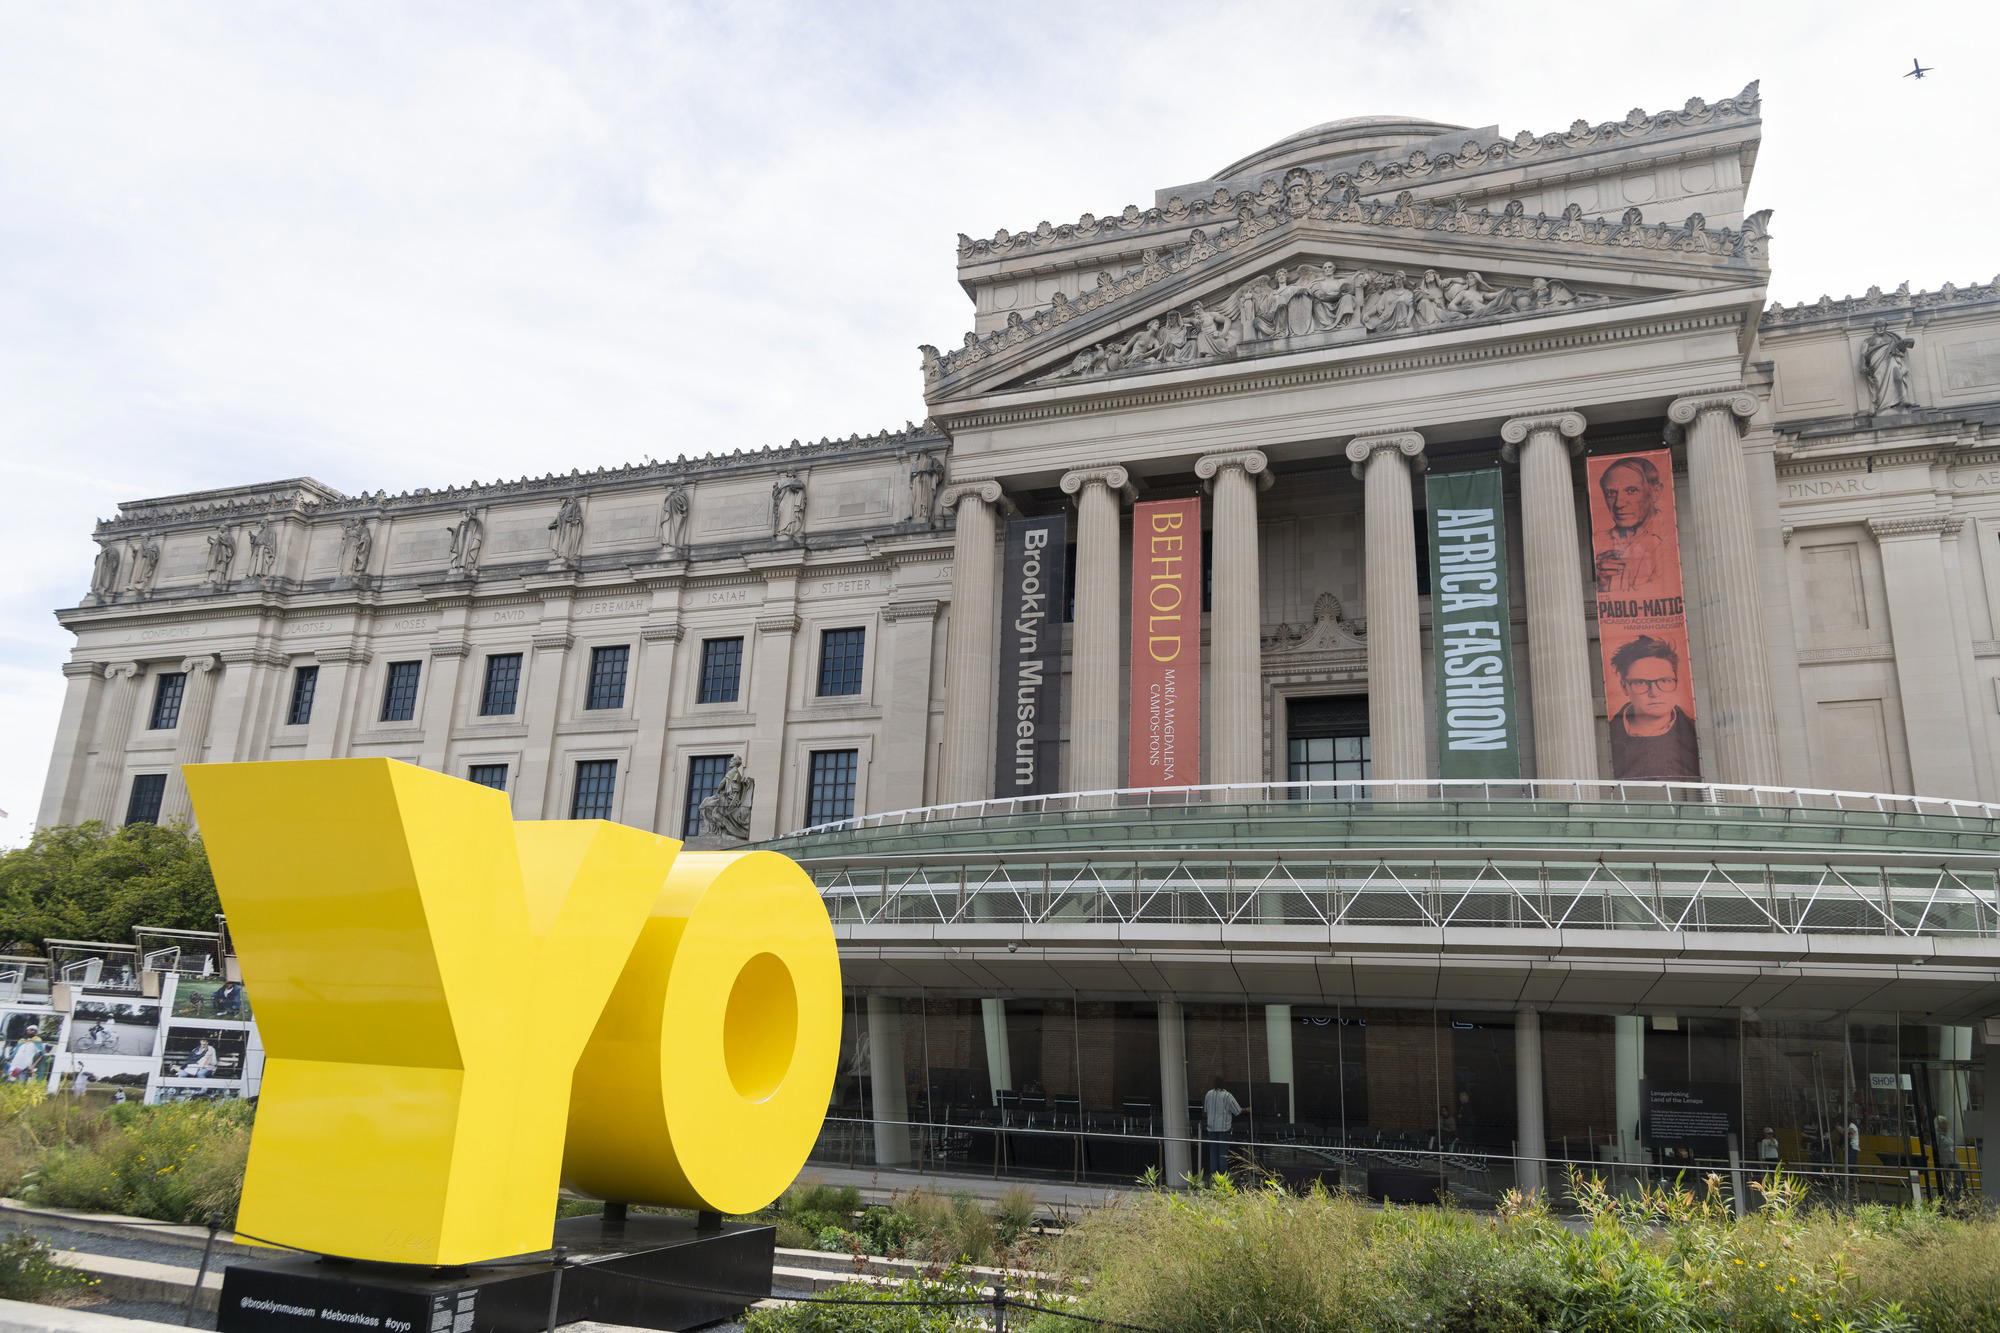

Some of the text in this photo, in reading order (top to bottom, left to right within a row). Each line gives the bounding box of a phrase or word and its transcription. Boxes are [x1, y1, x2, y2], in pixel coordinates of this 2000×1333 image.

[837, 579, 871, 592] PETER
[1148, 512, 1183, 662] BEHOLD
[586, 599, 644, 614] JEREMIAH
[707, 590, 747, 604] ISAIAH
[1599, 596, 1684, 618] PABLO-MATIC
[392, 618, 428, 632] MOSES
[493, 610, 526, 623] DAVID
[1437, 508, 1507, 751] AFRICA FASHION
[1015, 528, 1048, 785] Brooklyn Museum
[1150, 683, 1161, 766] CAMPOS-PONS
[1163, 669, 1177, 781] MARÍA MAGDALENA
[1871, 1076, 1895, 1086] SHOP
[240, 1296, 316, 1318] @brooklynmuseum
[321, 1308, 379, 1327] #deborahkass
[384, 1317, 411, 1332] #oyyo
